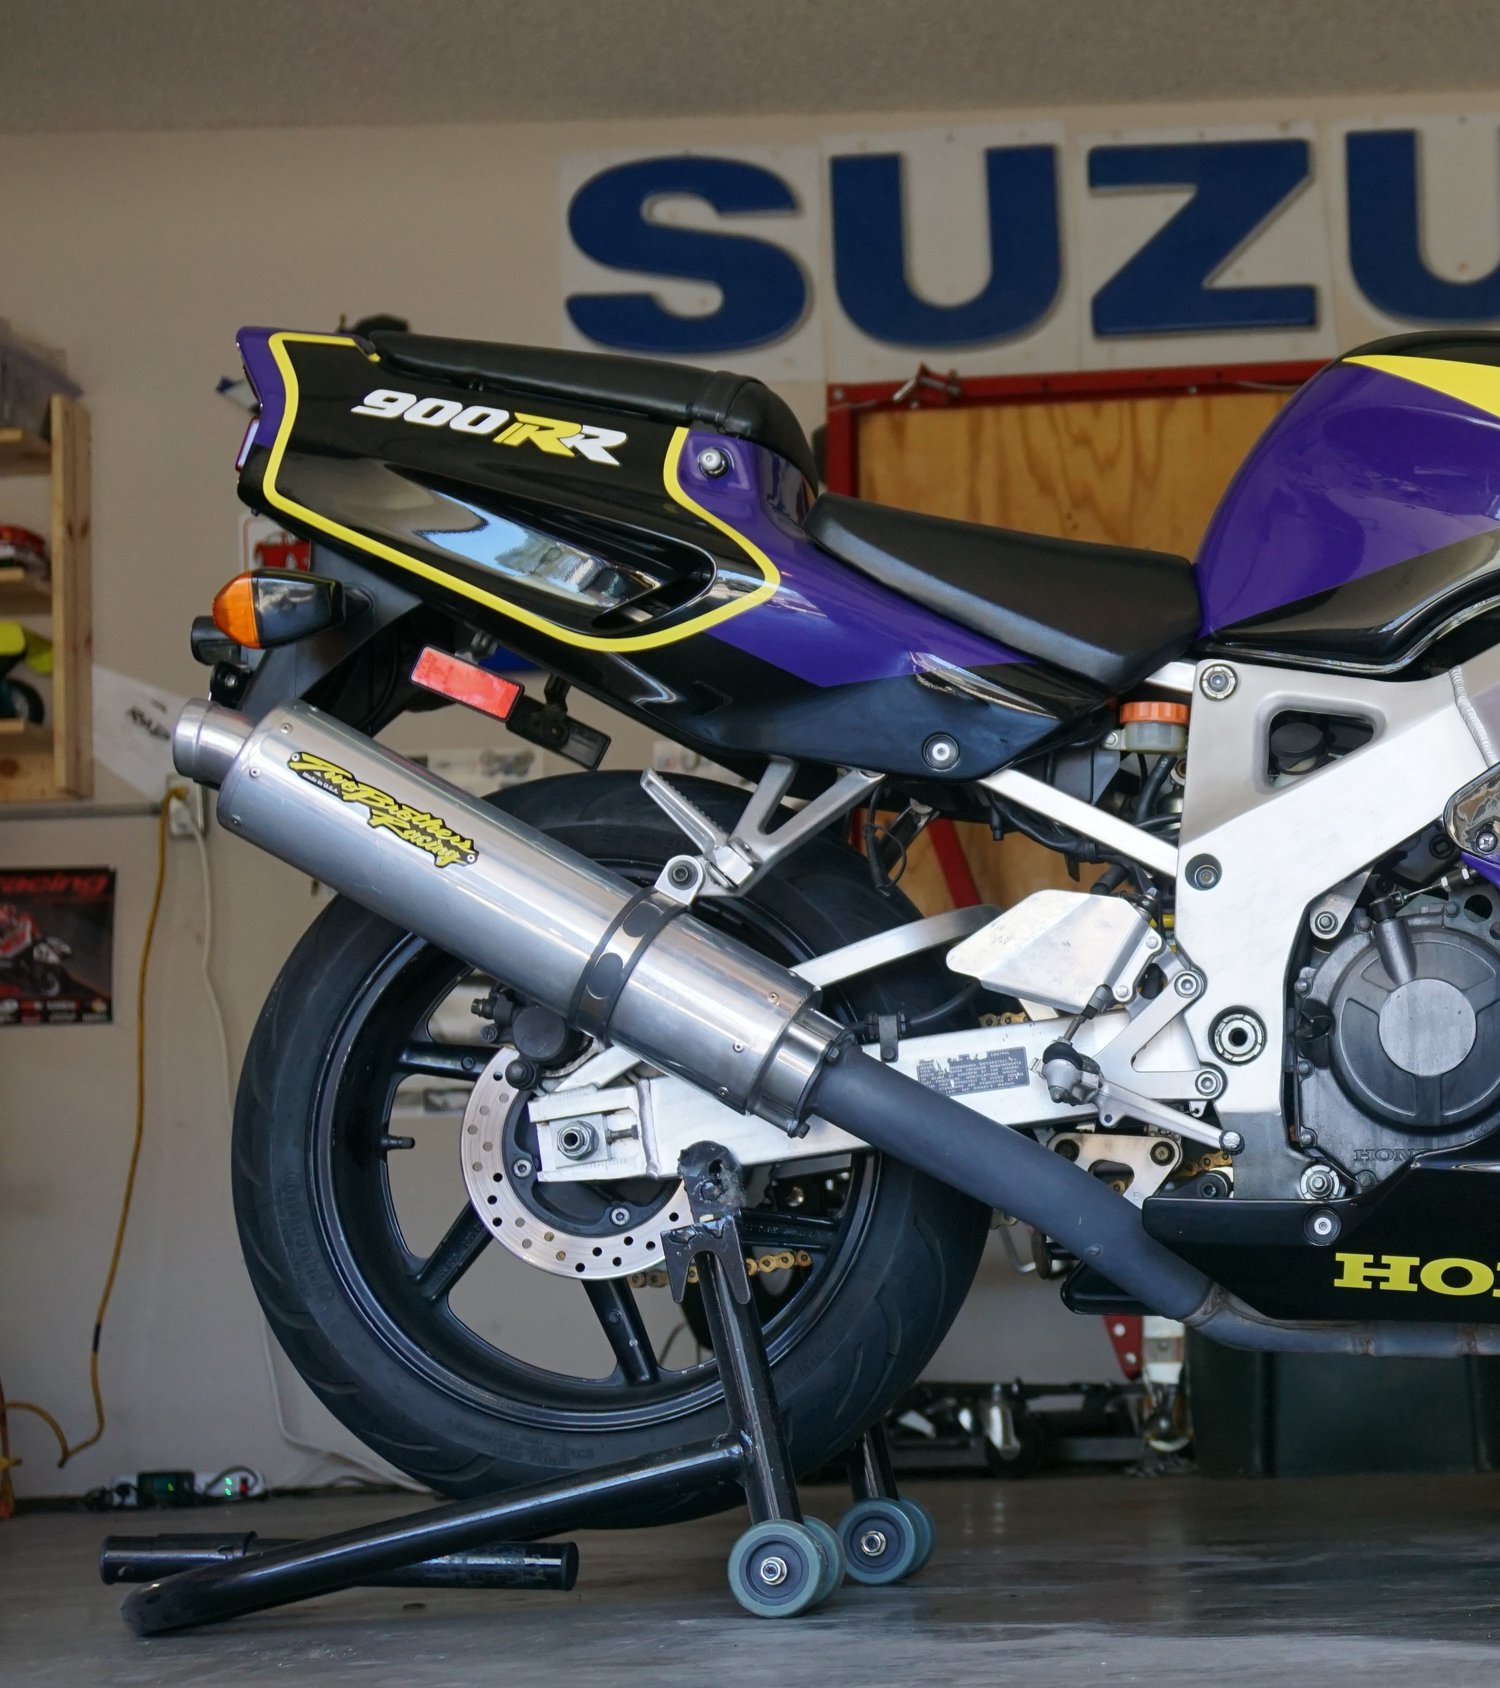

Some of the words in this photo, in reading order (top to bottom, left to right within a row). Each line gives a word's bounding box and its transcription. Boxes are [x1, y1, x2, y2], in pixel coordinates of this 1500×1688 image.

[342, 782, 479, 854] Brothers
[368, 808, 468, 868] Racing
[1353, 1147, 1415, 1162] HON
